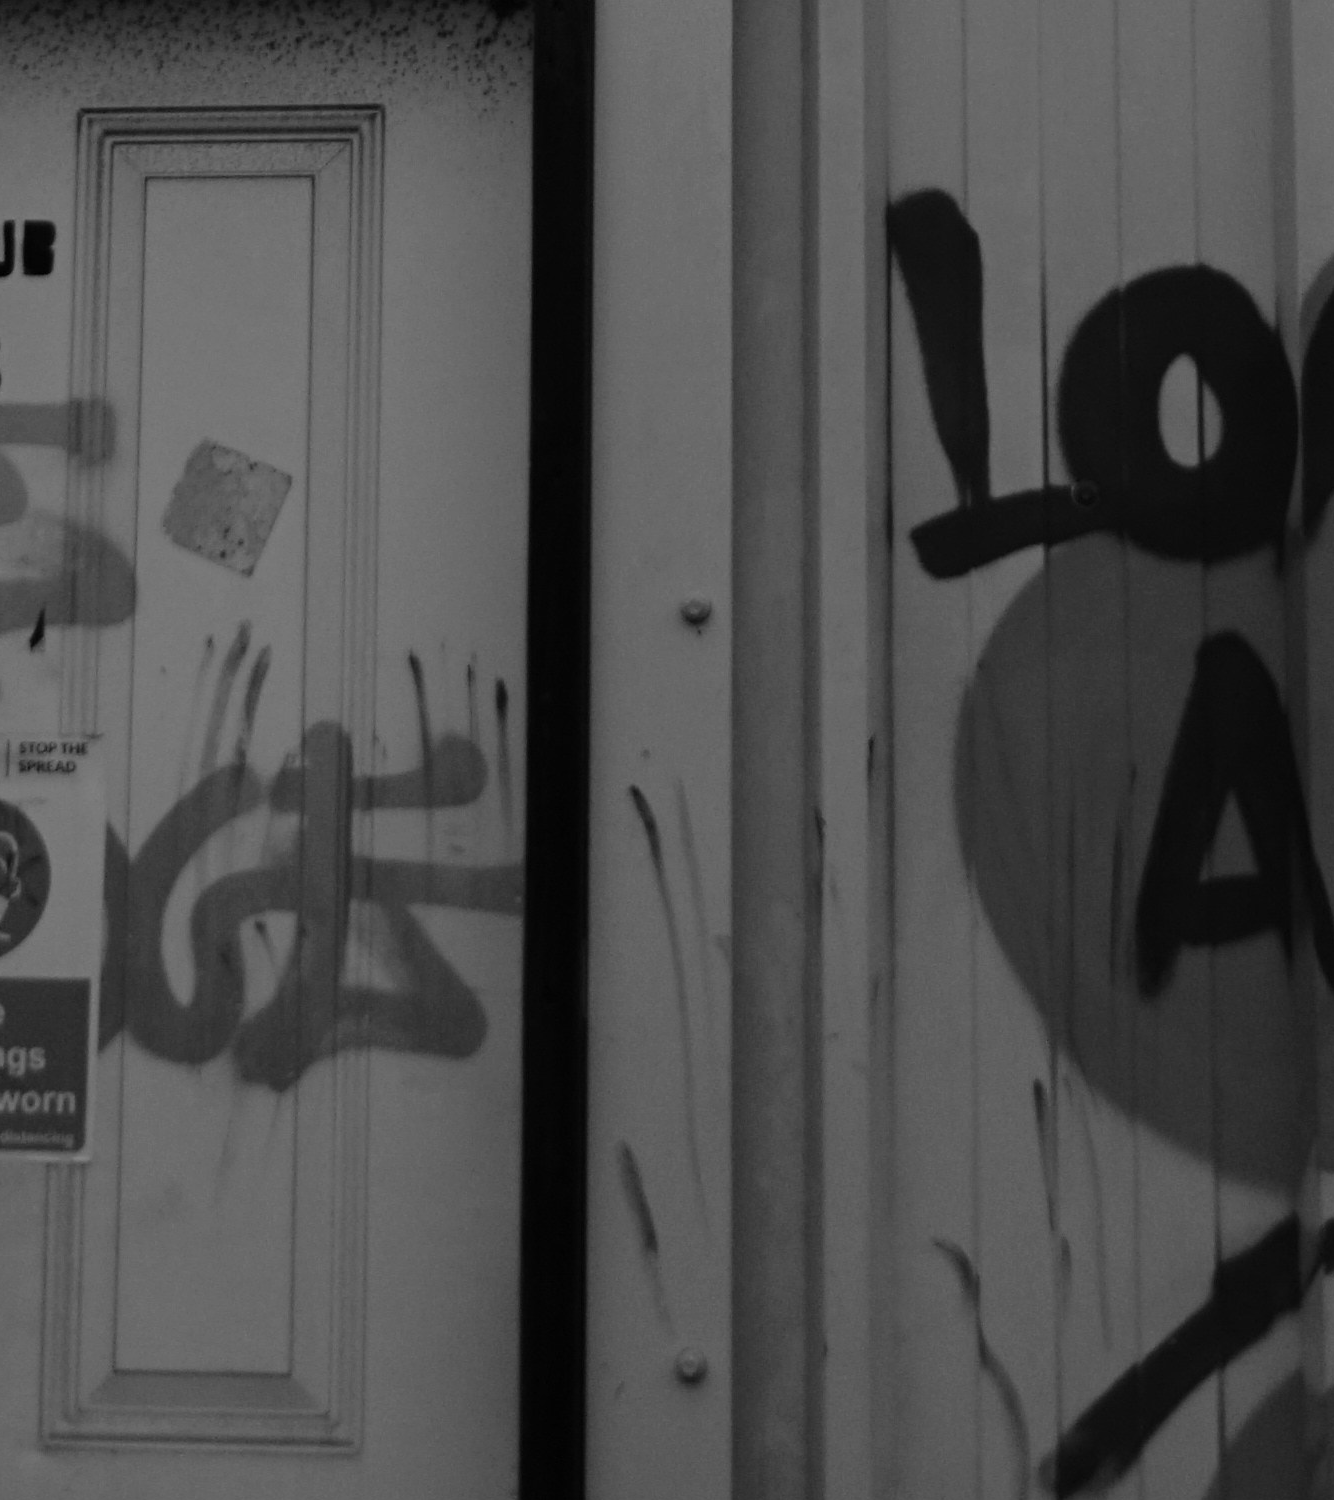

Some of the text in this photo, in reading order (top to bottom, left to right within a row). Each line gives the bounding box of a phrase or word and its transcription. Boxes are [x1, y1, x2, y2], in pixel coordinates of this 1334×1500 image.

[18, 741, 89, 756] STOP THE
[18, 759, 77, 775] SPREAD
